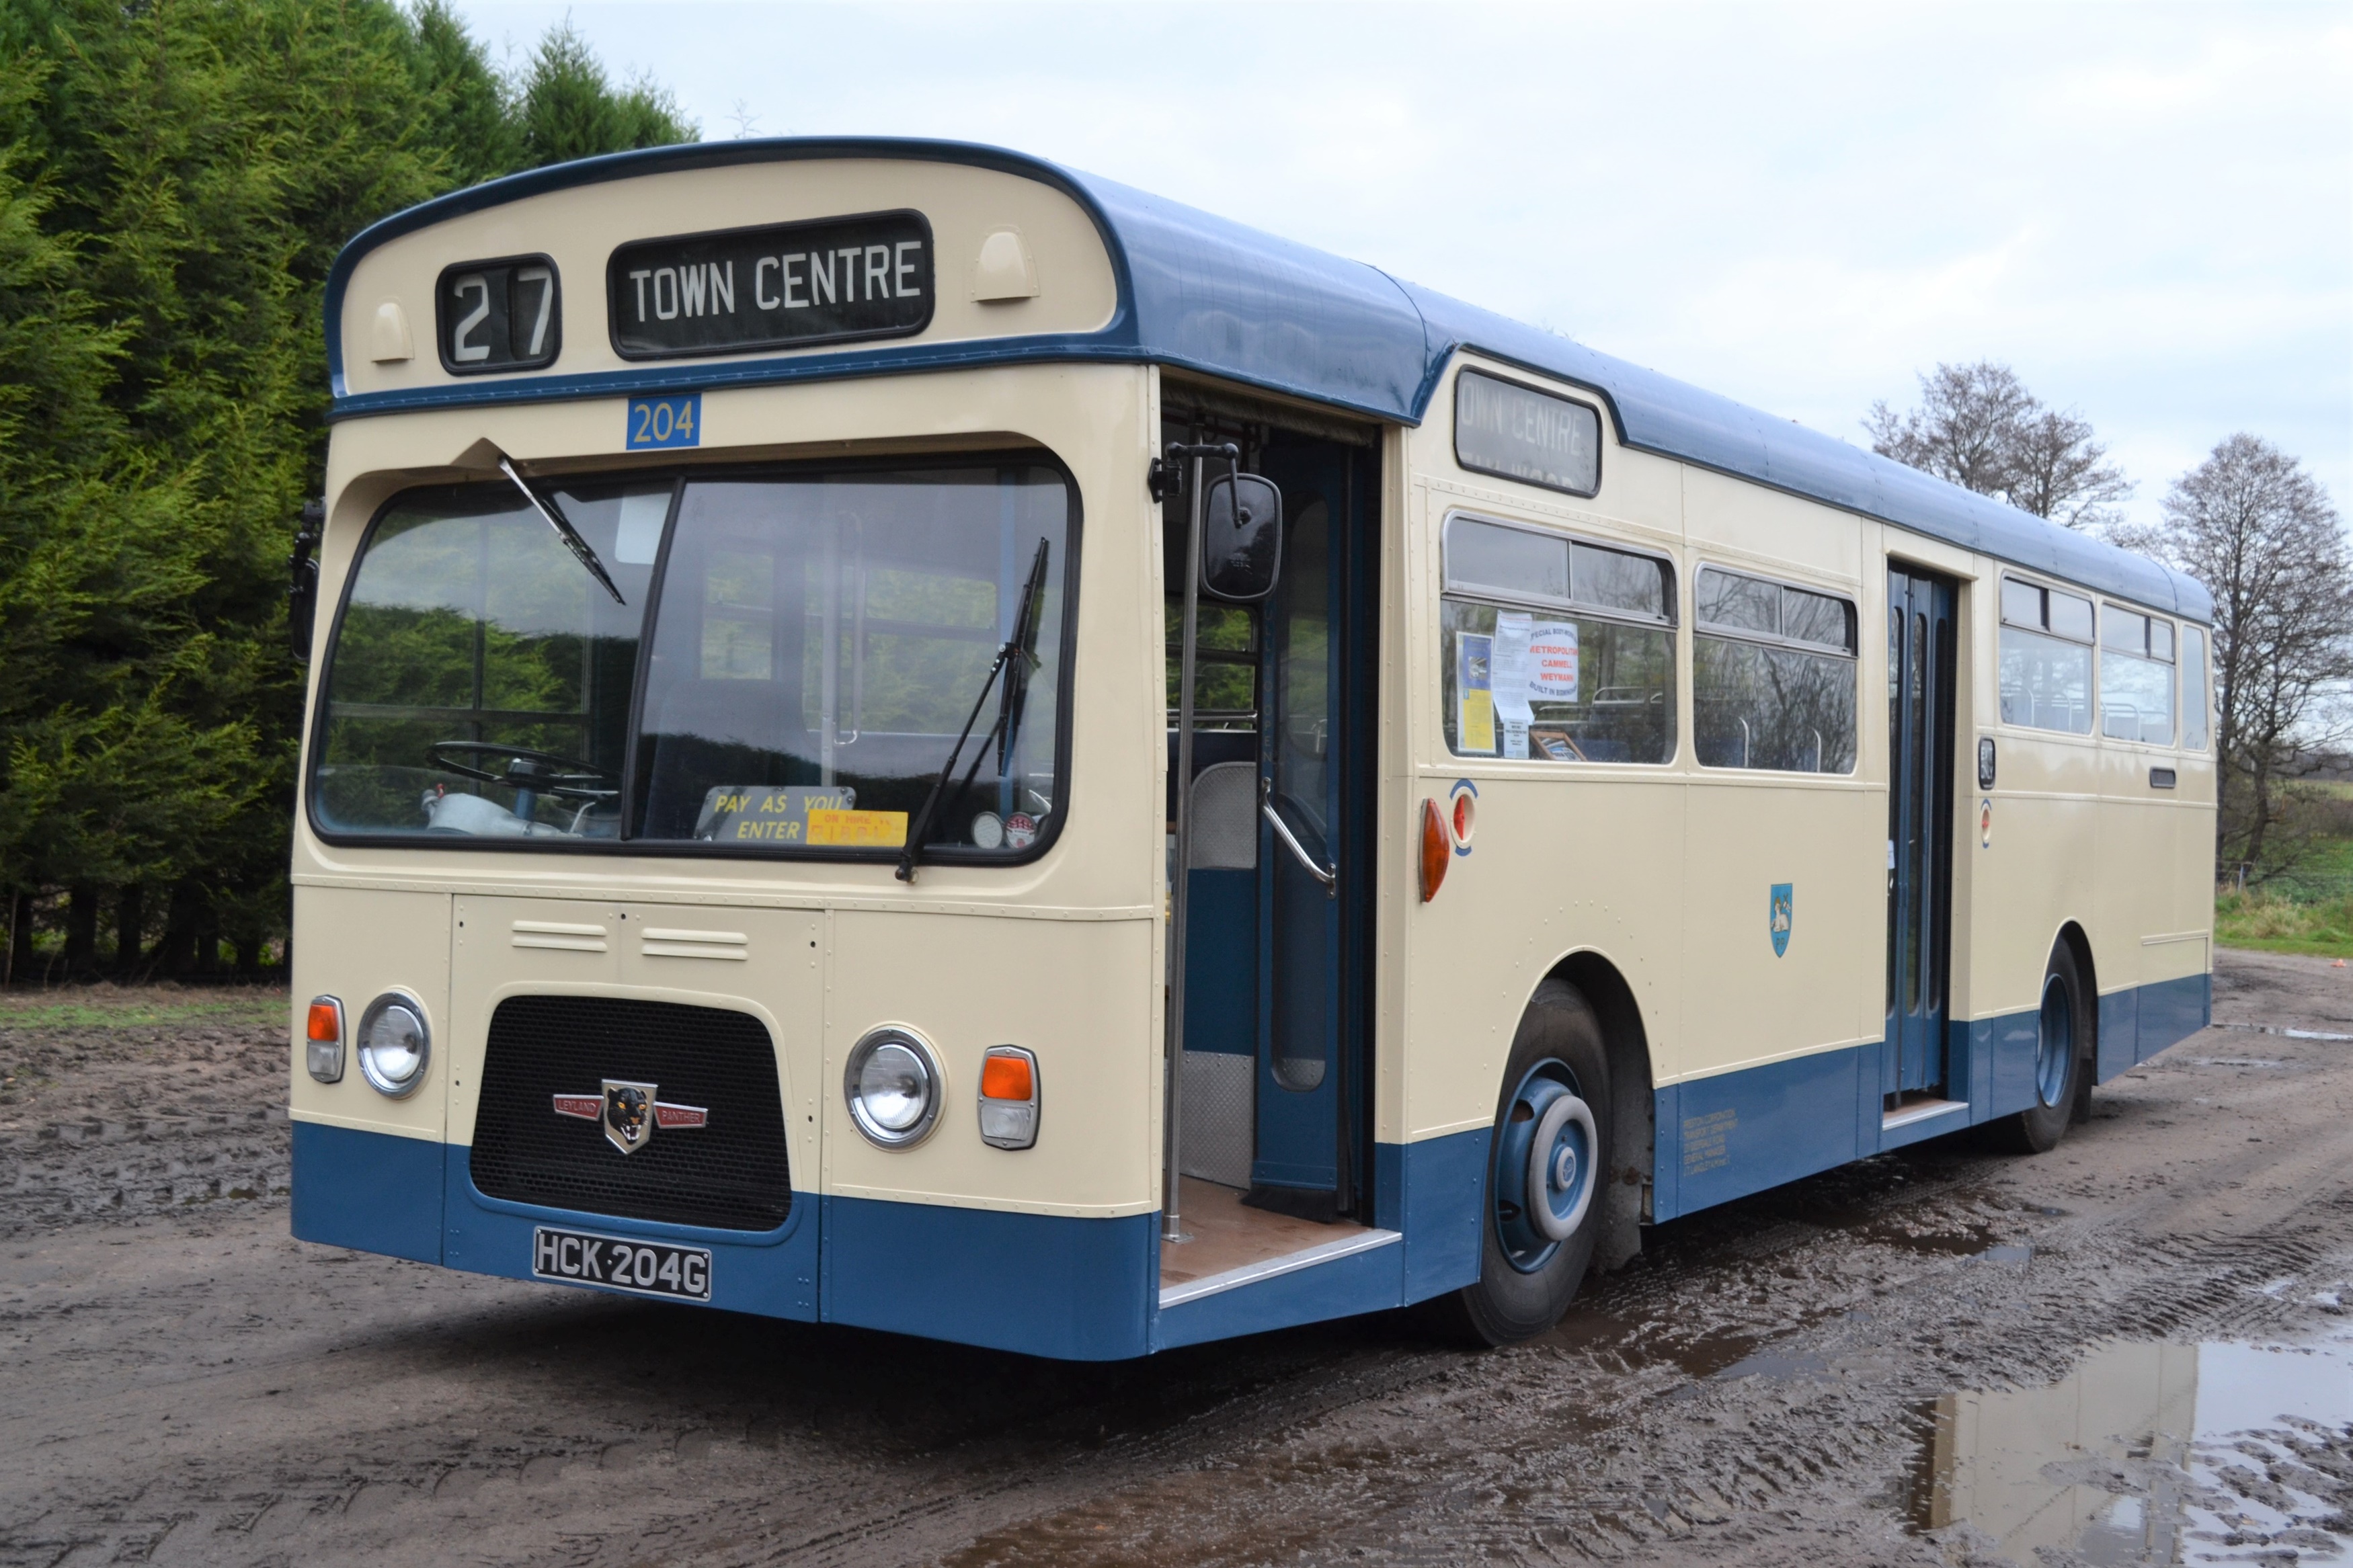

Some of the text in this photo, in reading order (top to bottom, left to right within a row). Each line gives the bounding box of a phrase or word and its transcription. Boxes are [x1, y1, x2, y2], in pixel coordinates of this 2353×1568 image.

[629, 241, 922, 323] TOWN CENTRE
[454, 267, 553, 362] 27
[633, 401, 693, 443] 204
[1512, 397, 1581, 457] CENTRE
[714, 794, 843, 813] PAY AS YOU
[824, 814, 839, 823] ON
[737, 821, 801, 840] ENTER
[559, 1100, 701, 1123] LEYLAND PANTHER
[538, 1233, 706, 1294] HCK 204G
